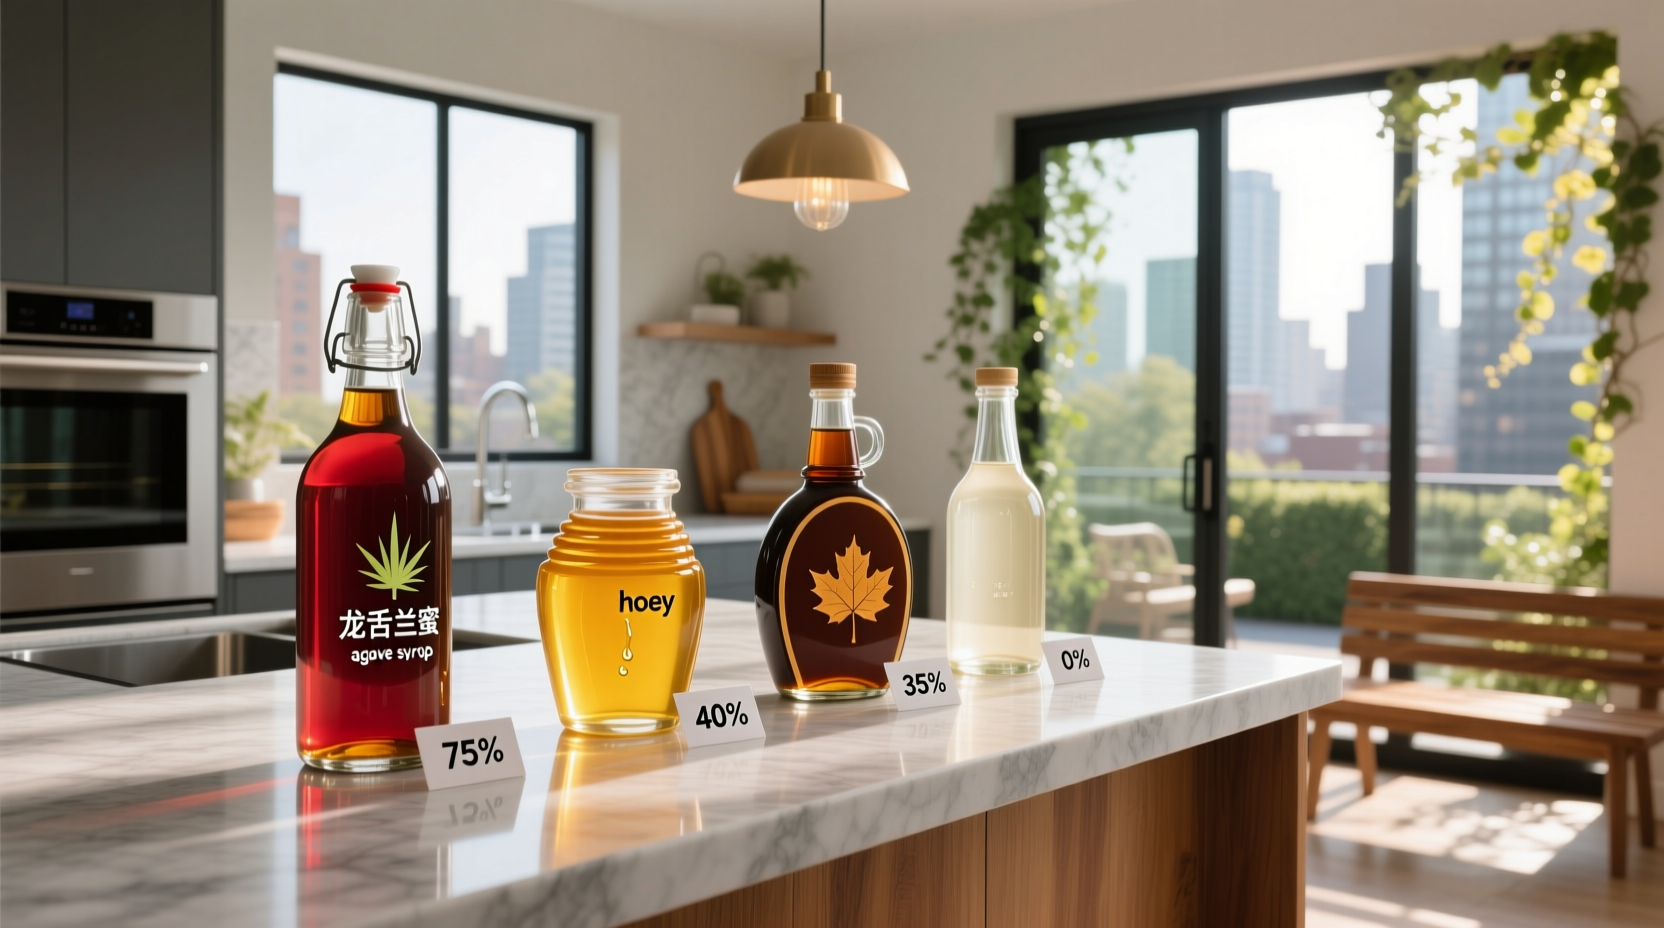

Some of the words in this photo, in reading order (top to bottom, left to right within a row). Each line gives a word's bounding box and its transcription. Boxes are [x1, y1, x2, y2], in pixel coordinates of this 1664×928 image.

[619, 589, 675, 617] hoey
[338, 605, 440, 640] 龙舌兰蜜
[396, 645, 434, 662] syrop
[1061, 648, 1090, 671] 0%
[902, 670, 947, 697] 35%
[695, 700, 749, 730] 40%
[441, 735, 504, 770] 75%
